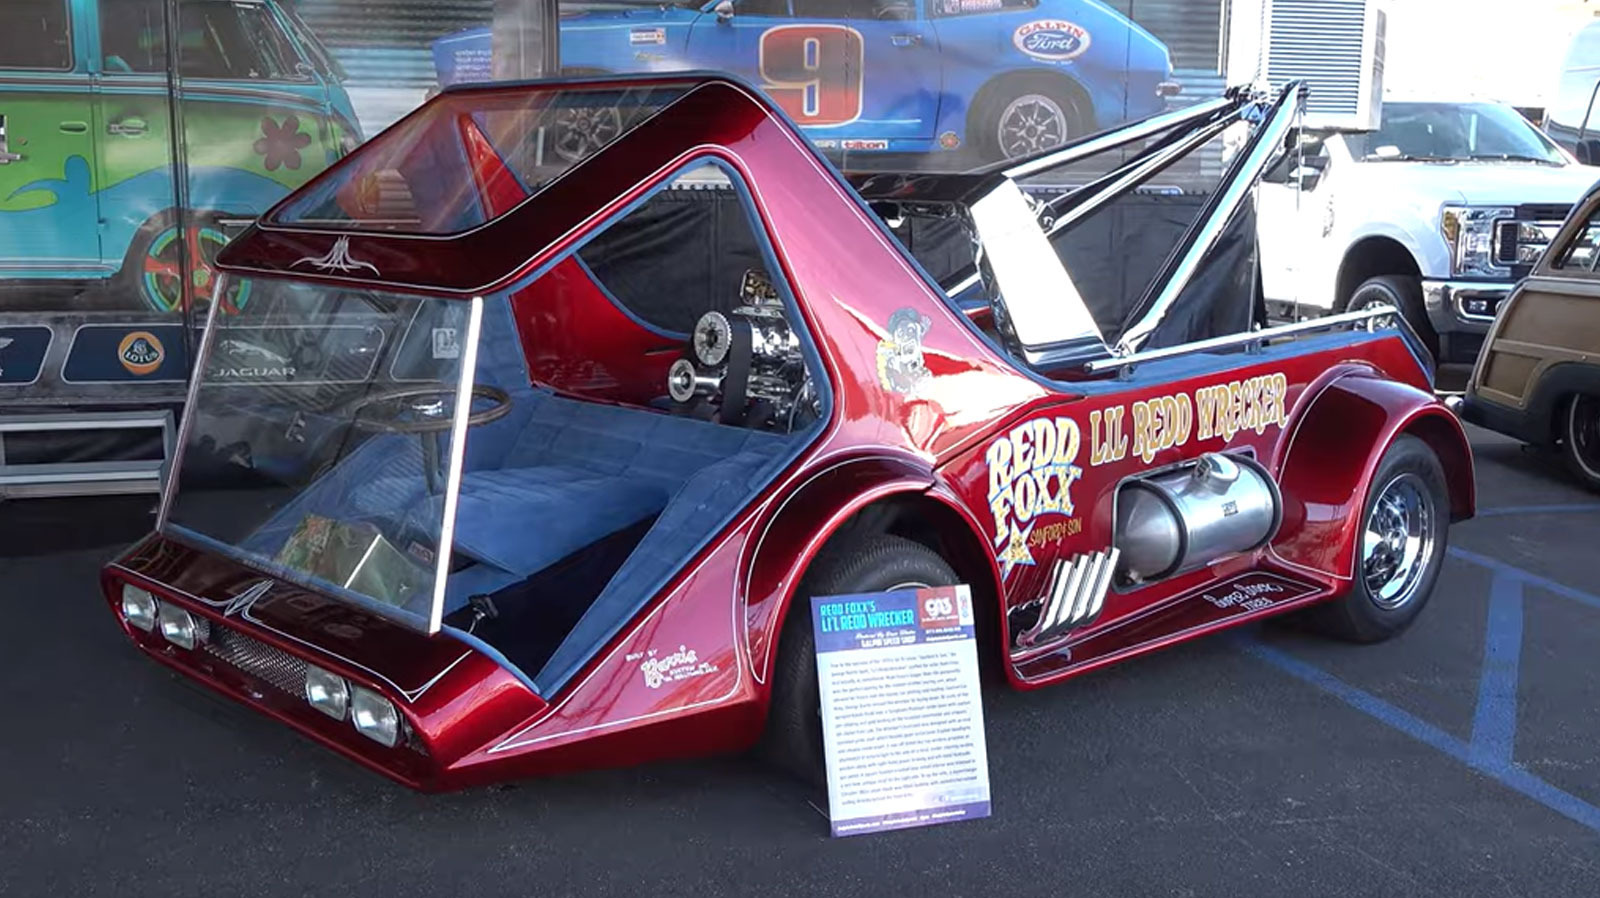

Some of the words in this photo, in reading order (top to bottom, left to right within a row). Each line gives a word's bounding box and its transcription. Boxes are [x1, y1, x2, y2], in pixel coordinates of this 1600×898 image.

[1019, 21, 1084, 38] GALPIN
[1027, 33, 1075, 50] Ford
[759, 23, 863, 129] 9
[844, 140, 885, 149] tilton
[124, 350, 159, 364] LOTUS
[213, 367, 296, 377] JAGUAR
[1090, 405, 1128, 465] LIL
[1132, 393, 1192, 463] REDD
[1196, 372, 1289, 441] WRECKER
[986, 417, 1080, 504] REDD
[990, 464, 1083, 548] FOXX
[1067, 517, 1082, 536] SON
[820, 603, 844, 616] REDD
[845, 600, 876, 615] FOXX'S
[821, 616, 840, 632] LI'L
[840, 614, 867, 631] REDD
[867, 609, 914, 628] WRECKER
